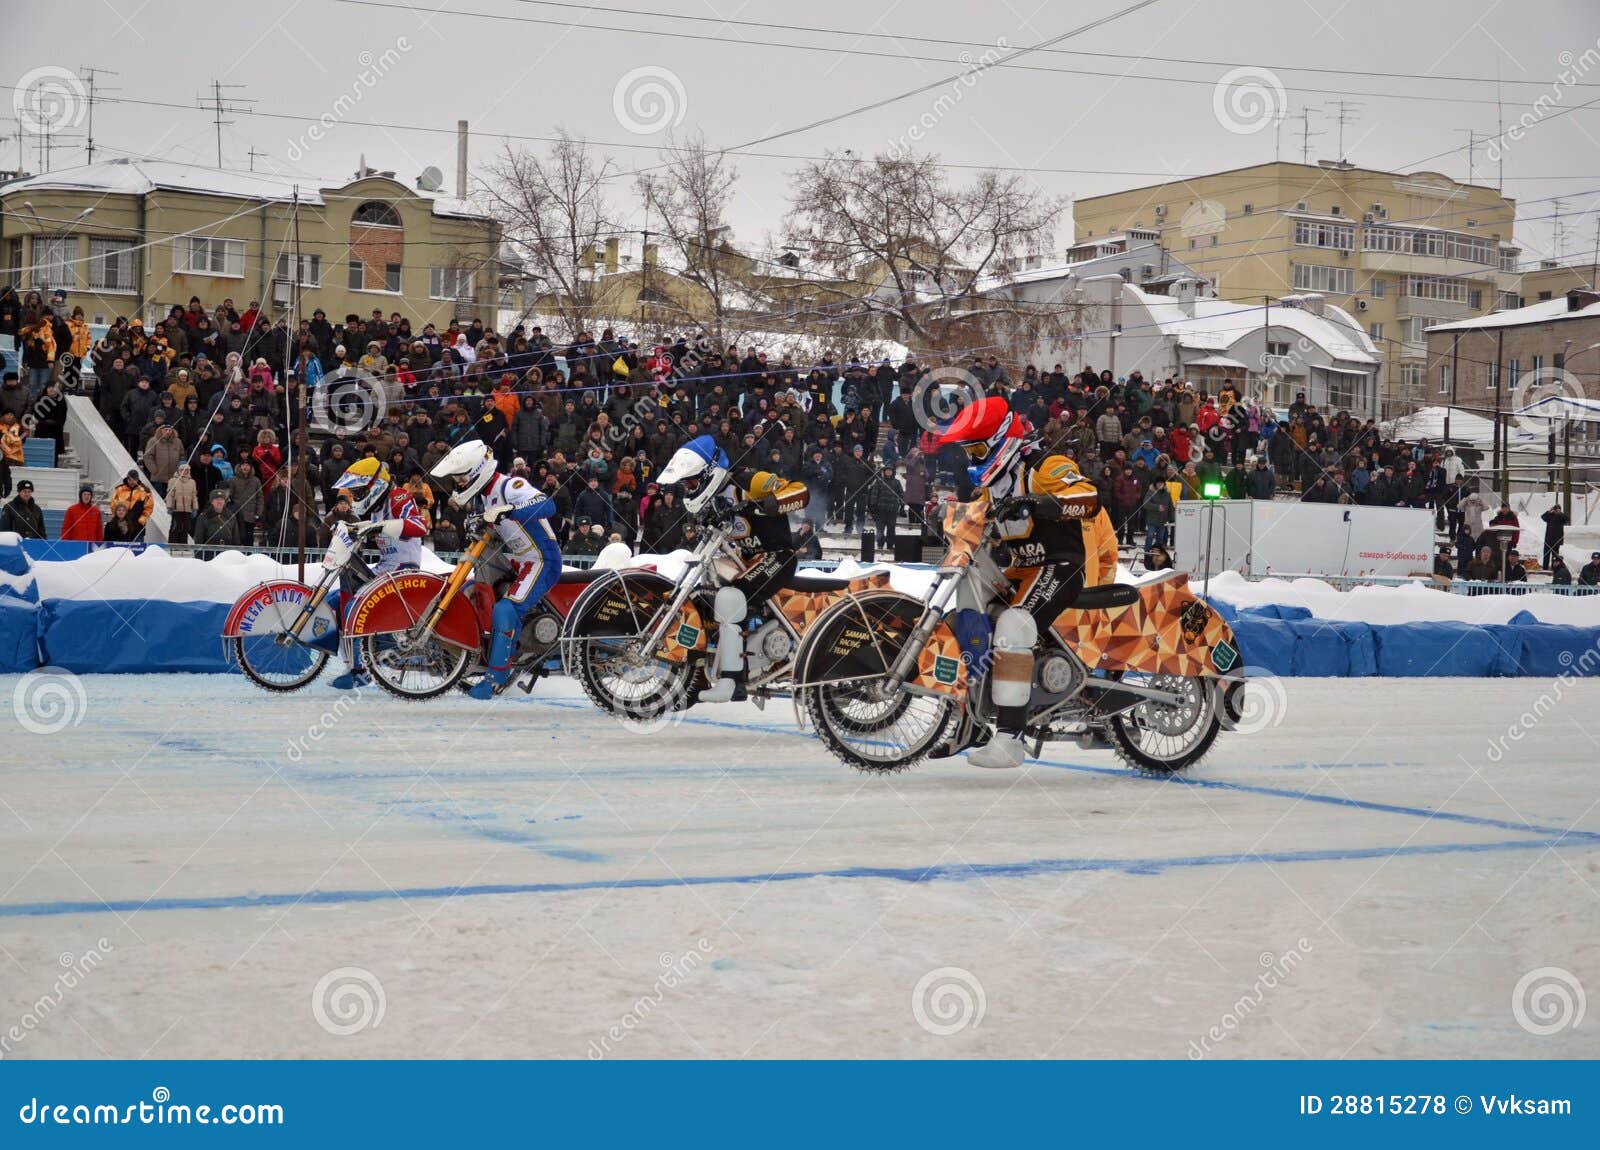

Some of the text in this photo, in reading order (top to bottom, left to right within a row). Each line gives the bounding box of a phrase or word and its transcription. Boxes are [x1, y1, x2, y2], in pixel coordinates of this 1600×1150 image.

[239, 589, 303, 632] MEGA LADA
[354, 579, 427, 634] БЛАГОВЕЩЕНСК
[844, 629, 870, 641] SAMARA
[839, 638, 861, 649] RACING
[833, 646, 850, 656] TEAM
